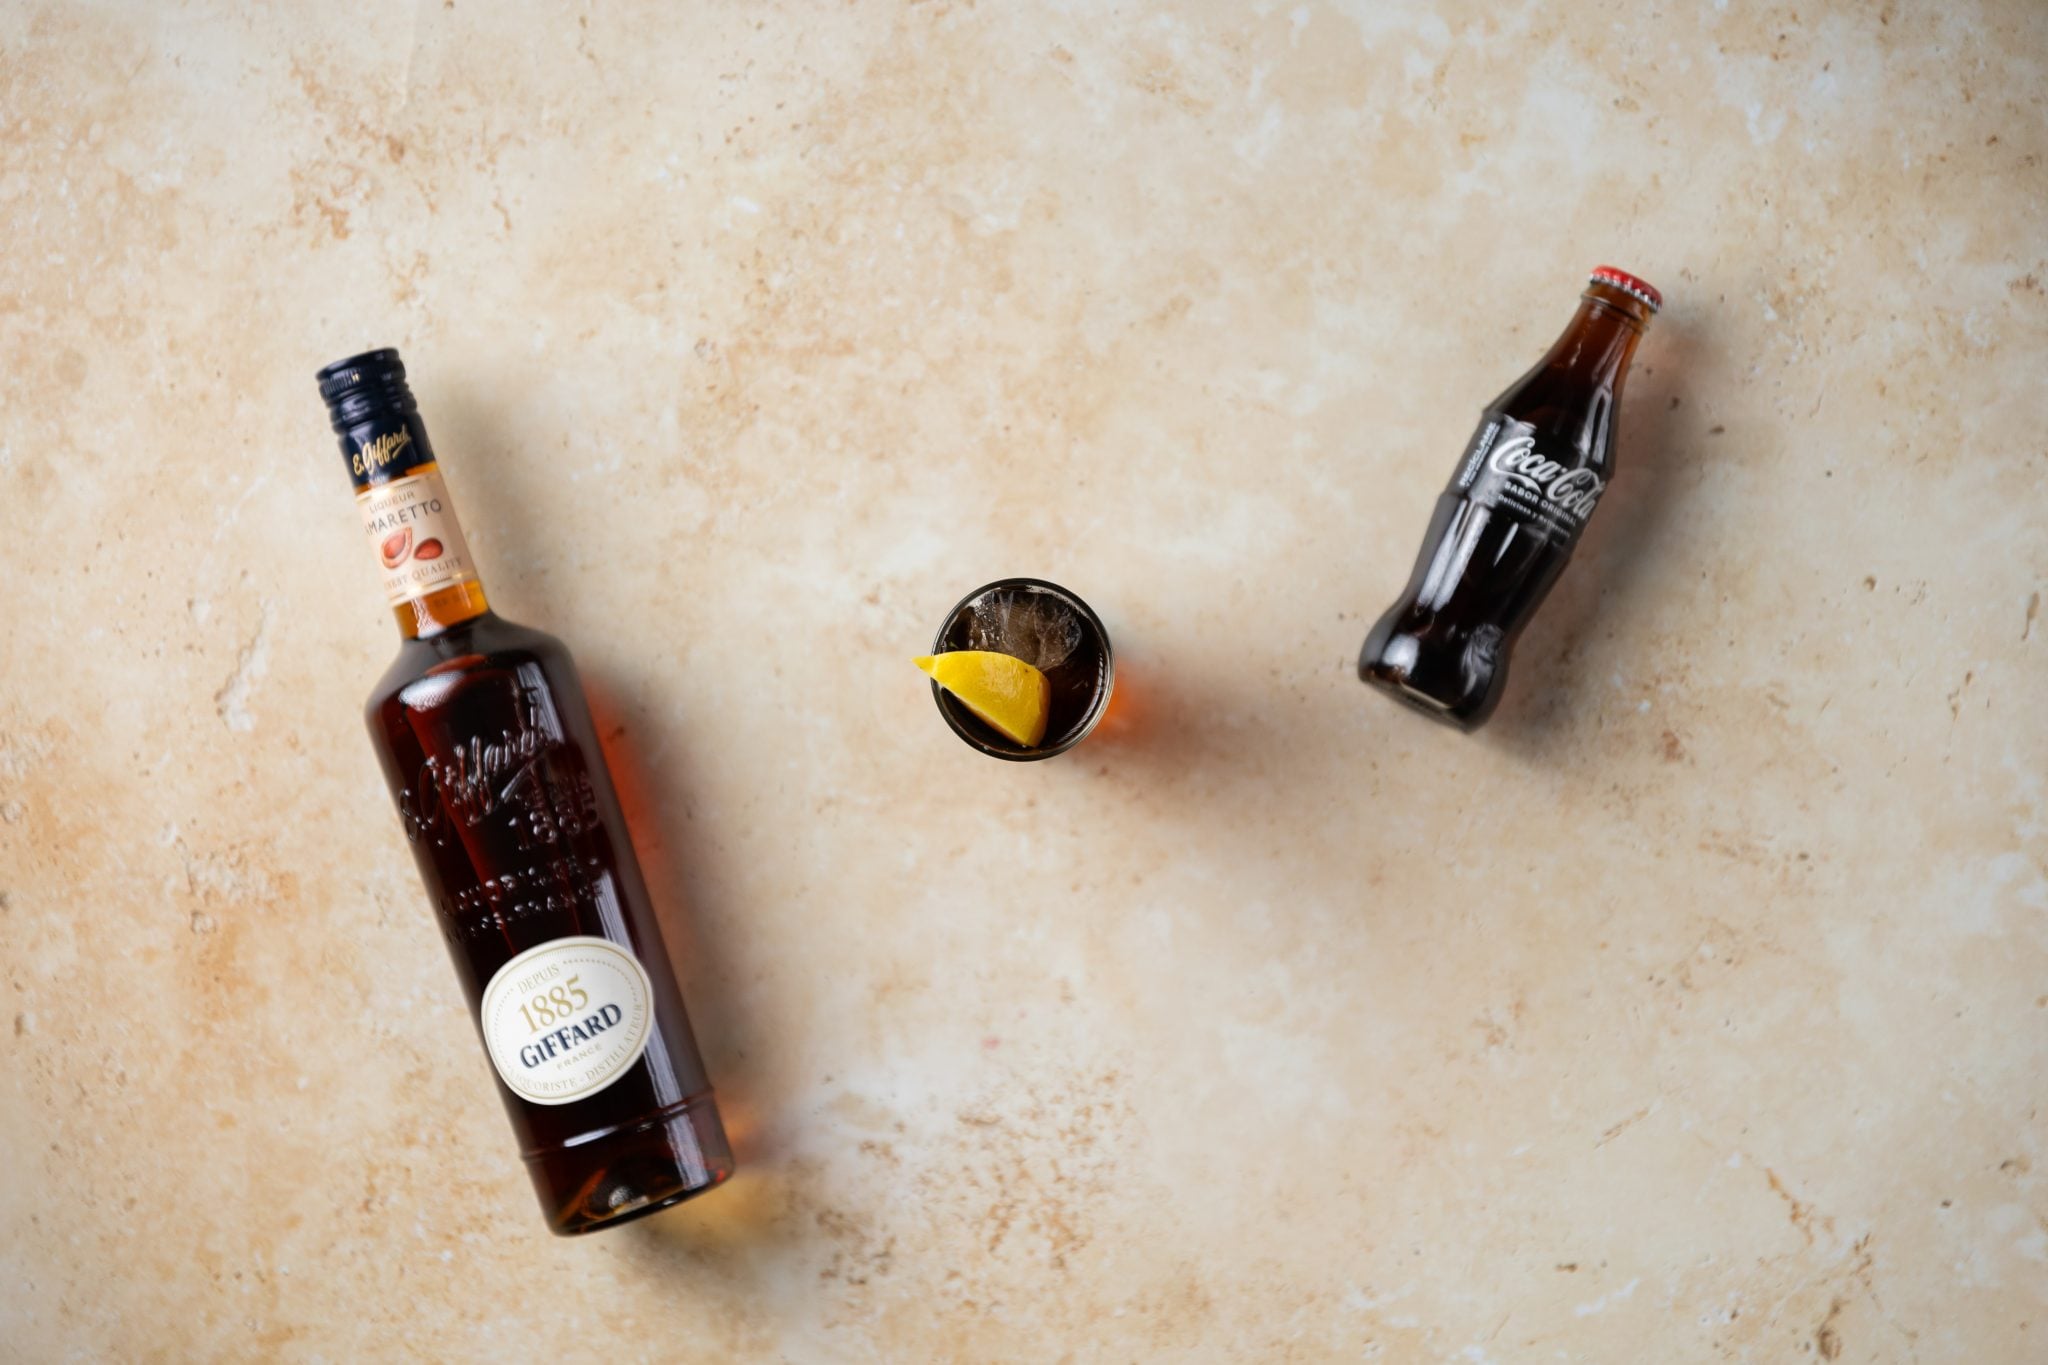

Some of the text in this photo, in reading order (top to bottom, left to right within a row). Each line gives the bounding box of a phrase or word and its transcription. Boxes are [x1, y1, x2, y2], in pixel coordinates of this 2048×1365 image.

[363, 424, 412, 476] Giffard
[1489, 436, 1606, 519] Coca-Cola
[369, 491, 415, 514] LIQUEUR
[1504, 481, 1540, 505] SABOR
[1541, 499, 1578, 527] ORIGINAL
[412, 557, 463, 581] QUALITY
[517, 963, 560, 995] DEPUIS
[518, 974, 589, 1035] 1885
[520, 1003, 622, 1069] GIFFARD
[557, 1044, 603, 1070] FRANCE
